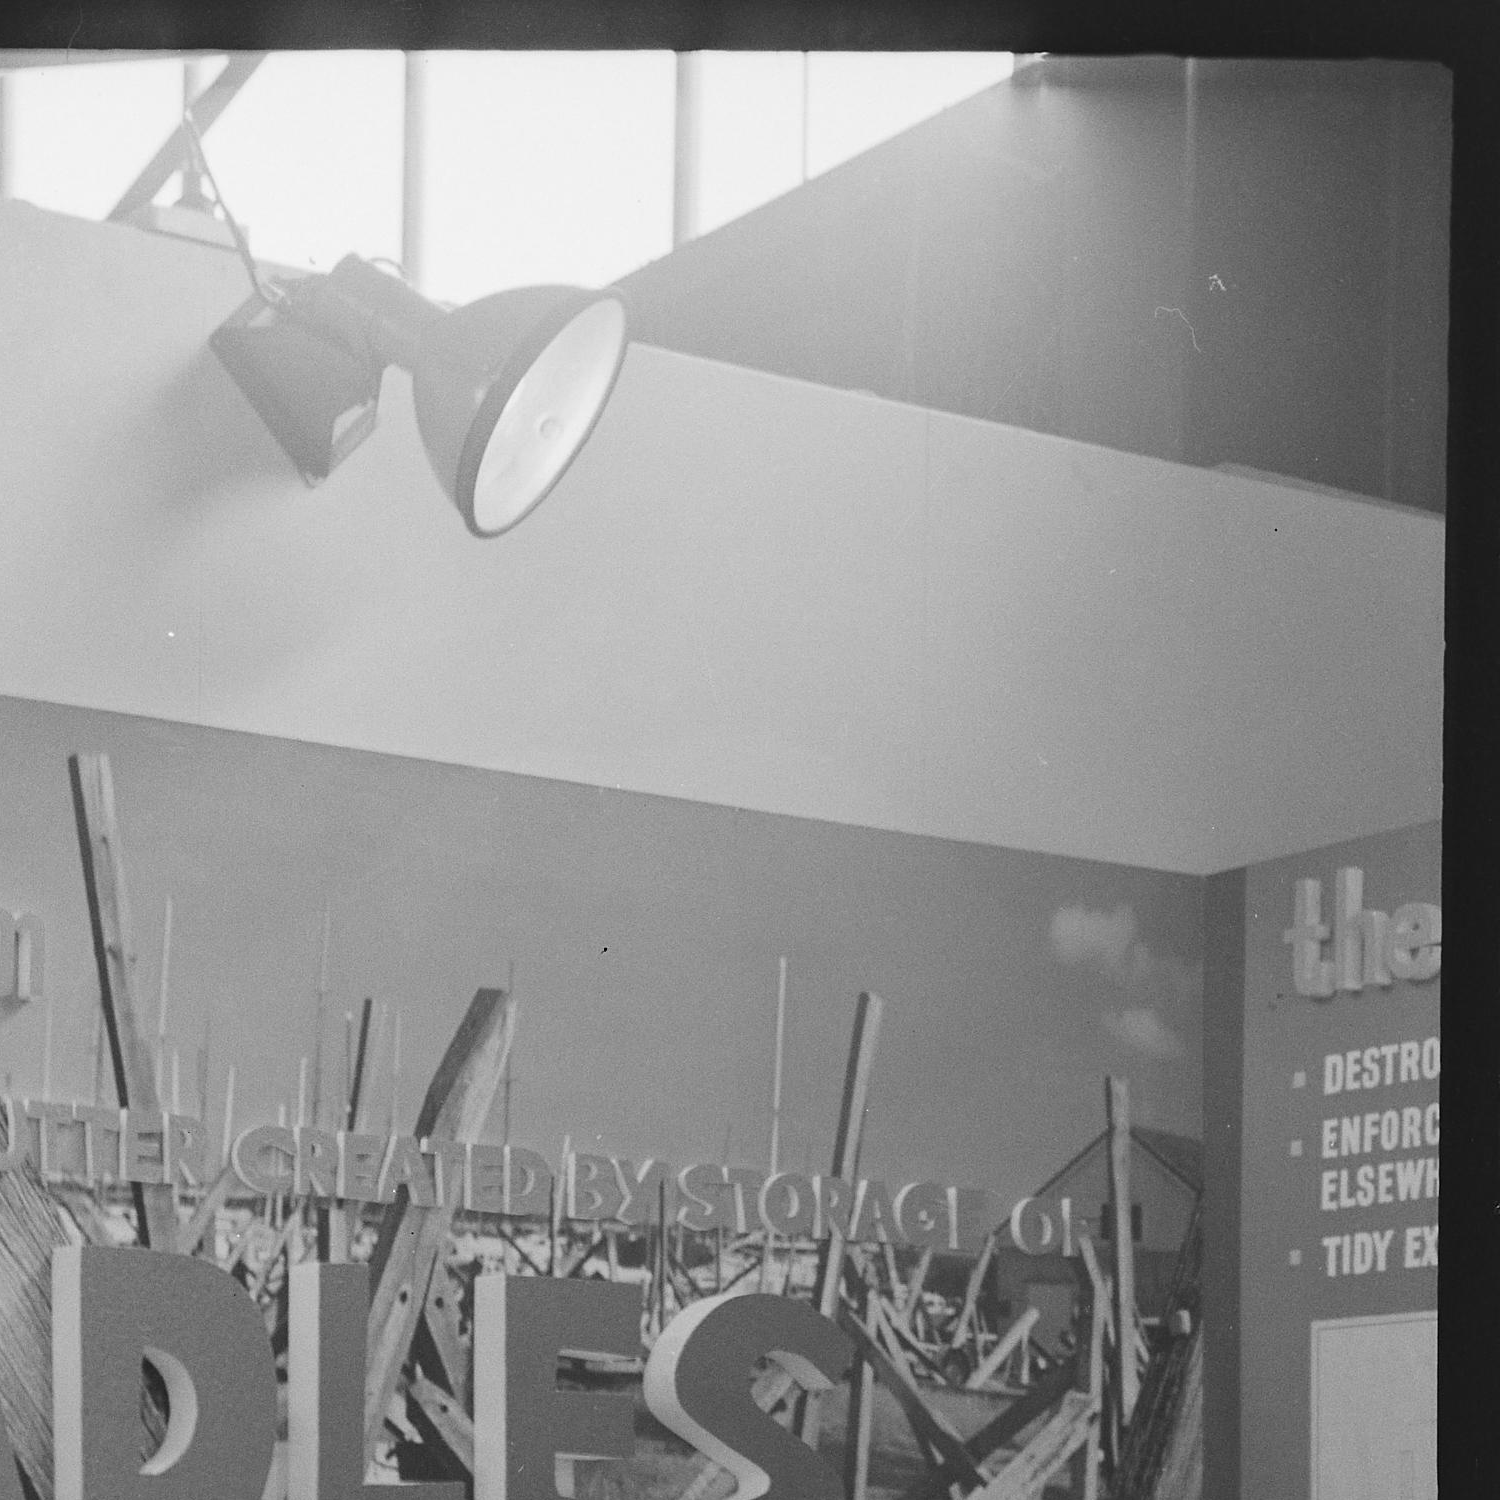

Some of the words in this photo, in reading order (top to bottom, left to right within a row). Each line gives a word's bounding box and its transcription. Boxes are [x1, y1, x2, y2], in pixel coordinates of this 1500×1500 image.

[1283, 866, 1442, 999] the
[1323, 1036, 1441, 1096] DESTRO
[1321, 1102, 1440, 1159] ENFORC
[231, 1124, 552, 1216] CREATED
[566, 1150, 670, 1226] BY
[676, 1163, 997, 1256] STORAGE
[1321, 1229, 1395, 1277] TIDY
